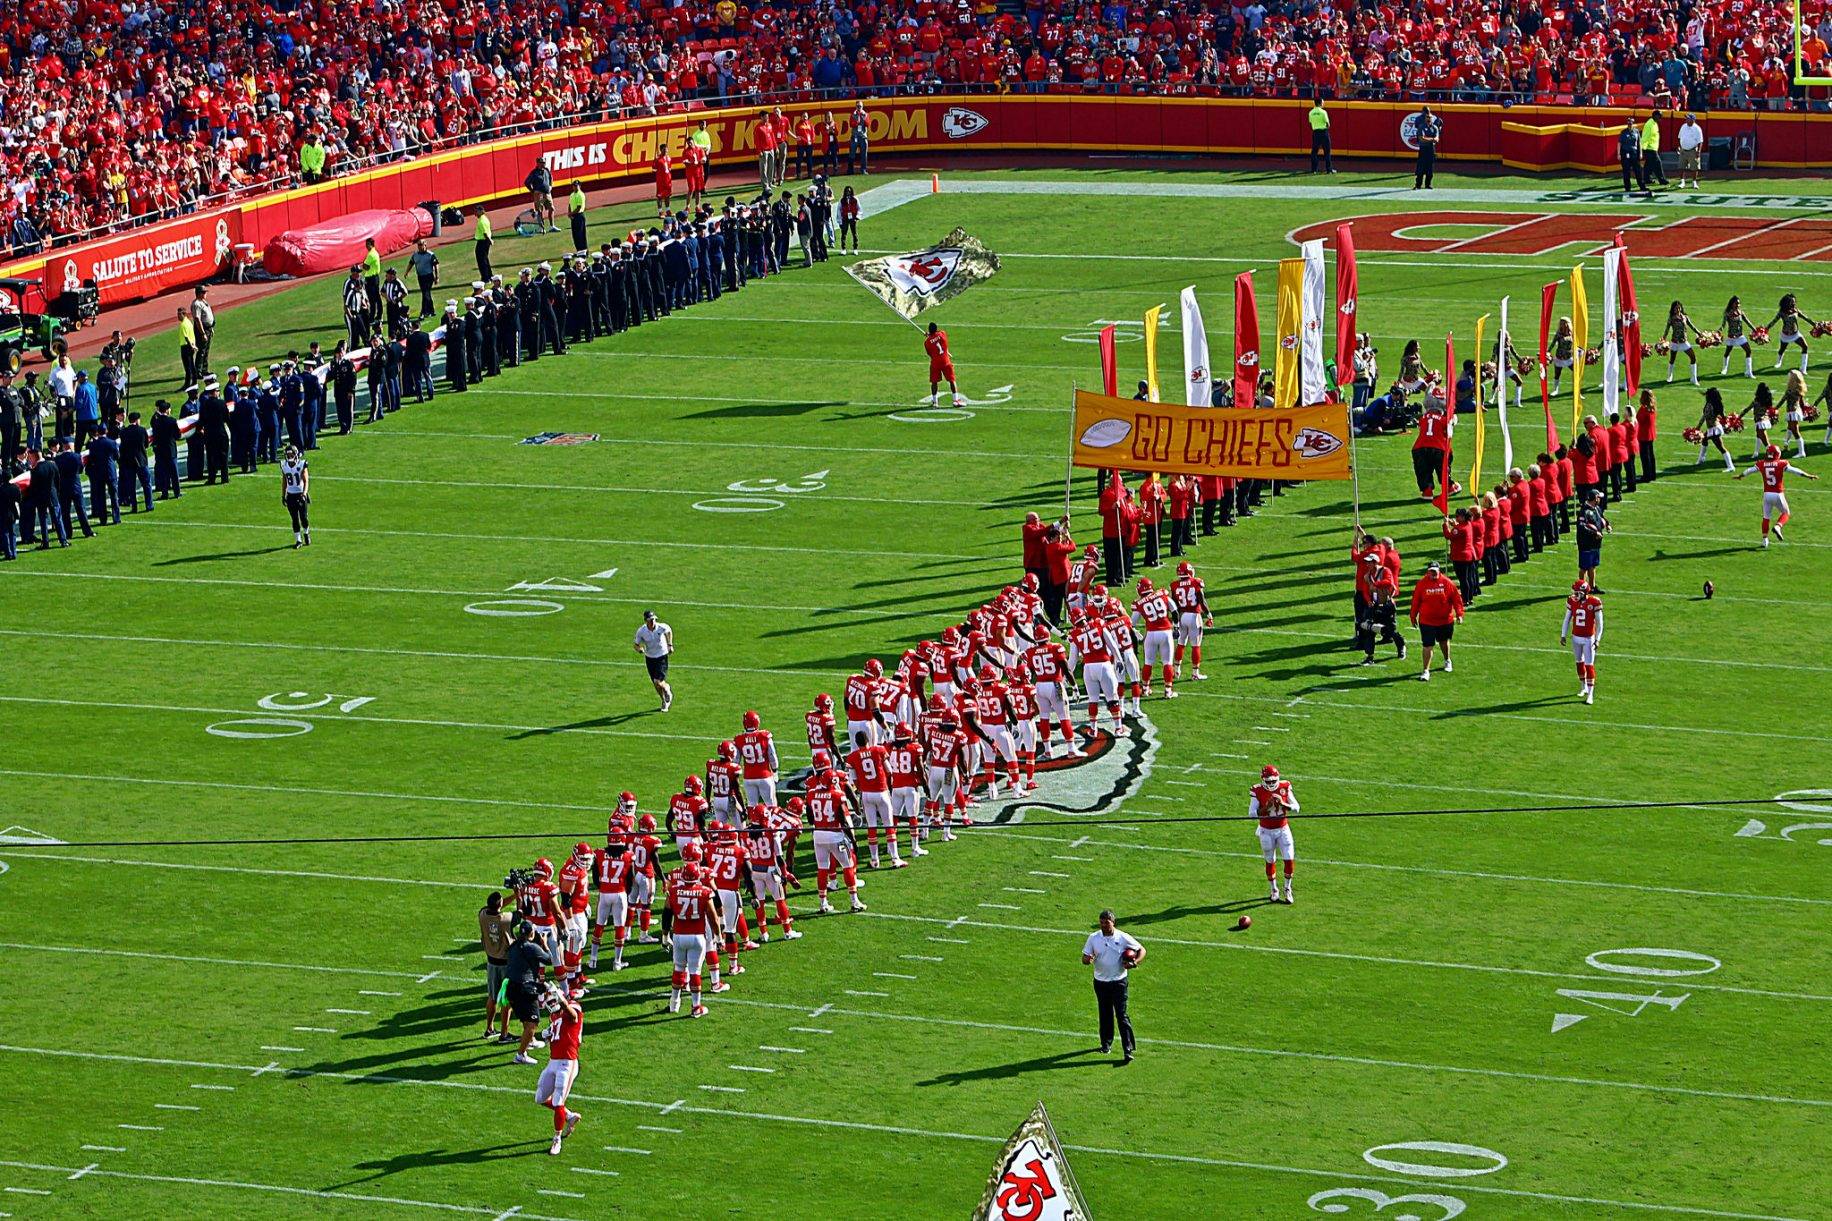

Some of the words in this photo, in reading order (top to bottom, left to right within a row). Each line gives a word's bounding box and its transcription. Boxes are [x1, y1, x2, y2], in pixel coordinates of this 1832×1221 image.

[542, 144, 585, 171] THIS
[588, 142, 607, 164] IS
[732, 109, 929, 151] KDOM
[92, 252, 137, 282] SALUTE
[137, 247, 154, 271] TO
[155, 234, 203, 267] SERVICE
[1426, 418, 1434, 436] 1
[1131, 413, 1173, 463] GO
[1183, 418, 1292, 467] CHIEFS
[286, 472, 300, 486] 81
[1765, 467, 1777, 487] 5
[1175, 586, 1198, 608] 34
[1143, 597, 1168, 623] 99
[1575, 608, 1587, 627] 2
[1076, 627, 1104, 654] 75
[1032, 653, 1057, 676] 95
[848, 685, 866, 710] 70
[979, 696, 1003, 717] 93
[742, 743, 765, 764] 91
[931, 737, 954, 762] 57
[861, 758, 877, 780] 9
[889, 751, 912, 774] 48
[708, 771, 730, 795] 20
[672, 806, 695, 831] 29
[811, 799, 835, 823] 84
[600, 859, 625, 884] 17
[710, 853, 737, 880] 73
[676, 889, 703, 897] SCHWARTZ
[677, 897, 700, 920] 71
